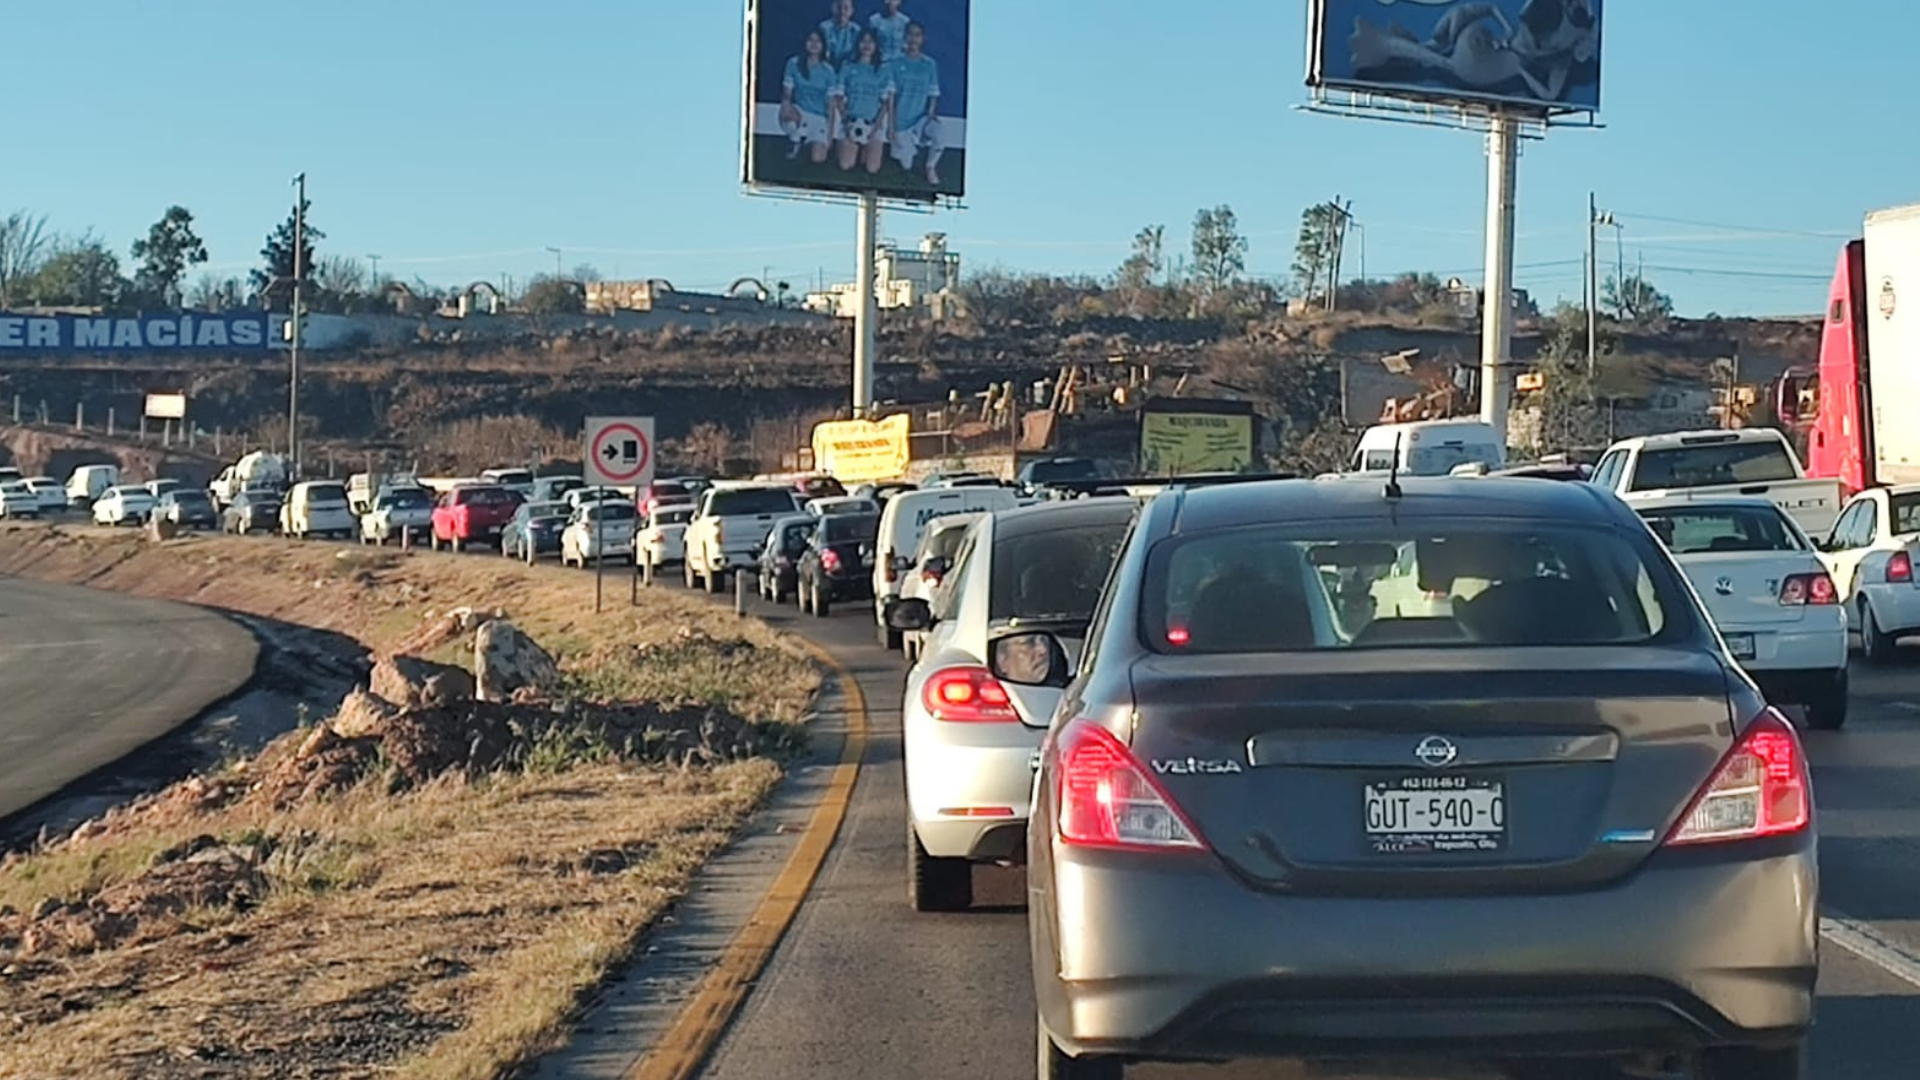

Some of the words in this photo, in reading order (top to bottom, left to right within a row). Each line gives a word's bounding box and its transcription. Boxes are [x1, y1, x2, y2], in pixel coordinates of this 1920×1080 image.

[0, 318, 60, 347] ER
[74, 315, 262, 347] MACÍAS
[1151, 757, 1242, 774] VERSA
